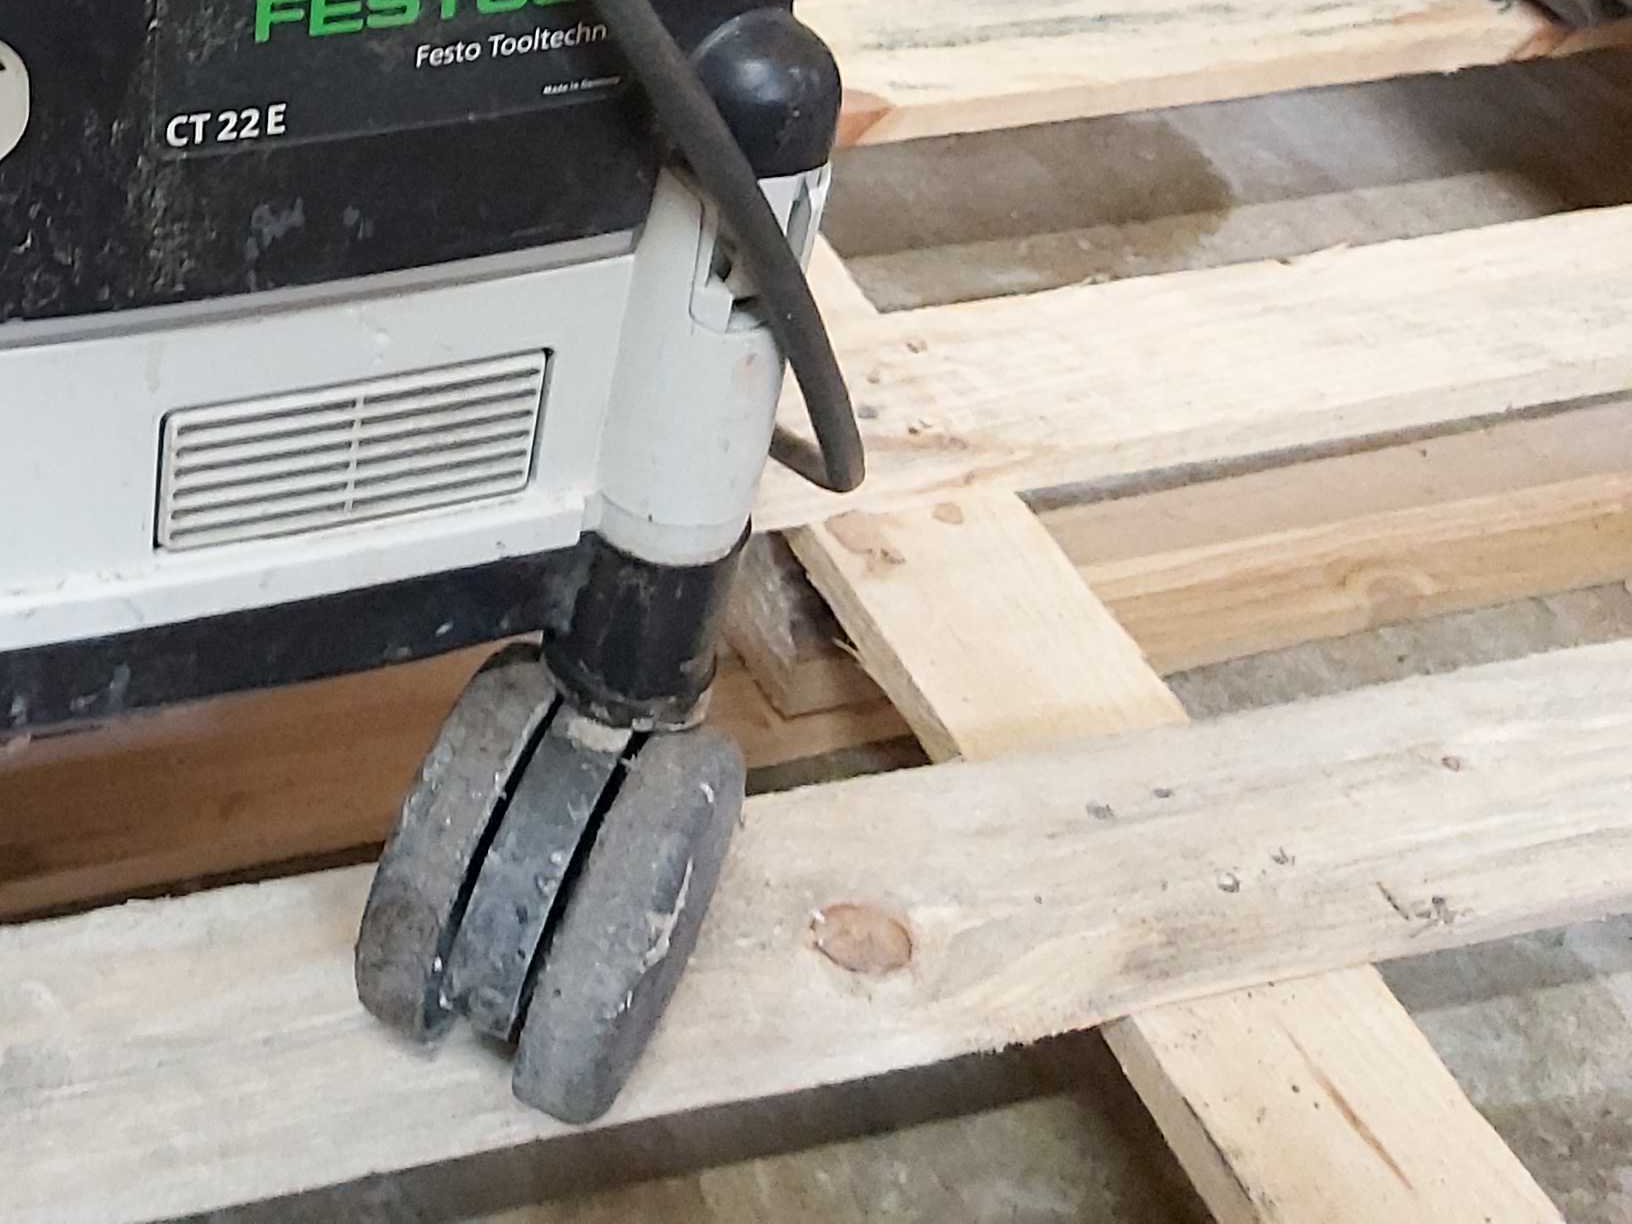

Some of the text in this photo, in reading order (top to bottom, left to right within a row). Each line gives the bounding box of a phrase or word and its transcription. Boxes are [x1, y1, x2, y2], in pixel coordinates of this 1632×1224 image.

[415, 21, 608, 68] Festo Tooltechn
[166, 102, 287, 147] CT 22 E
